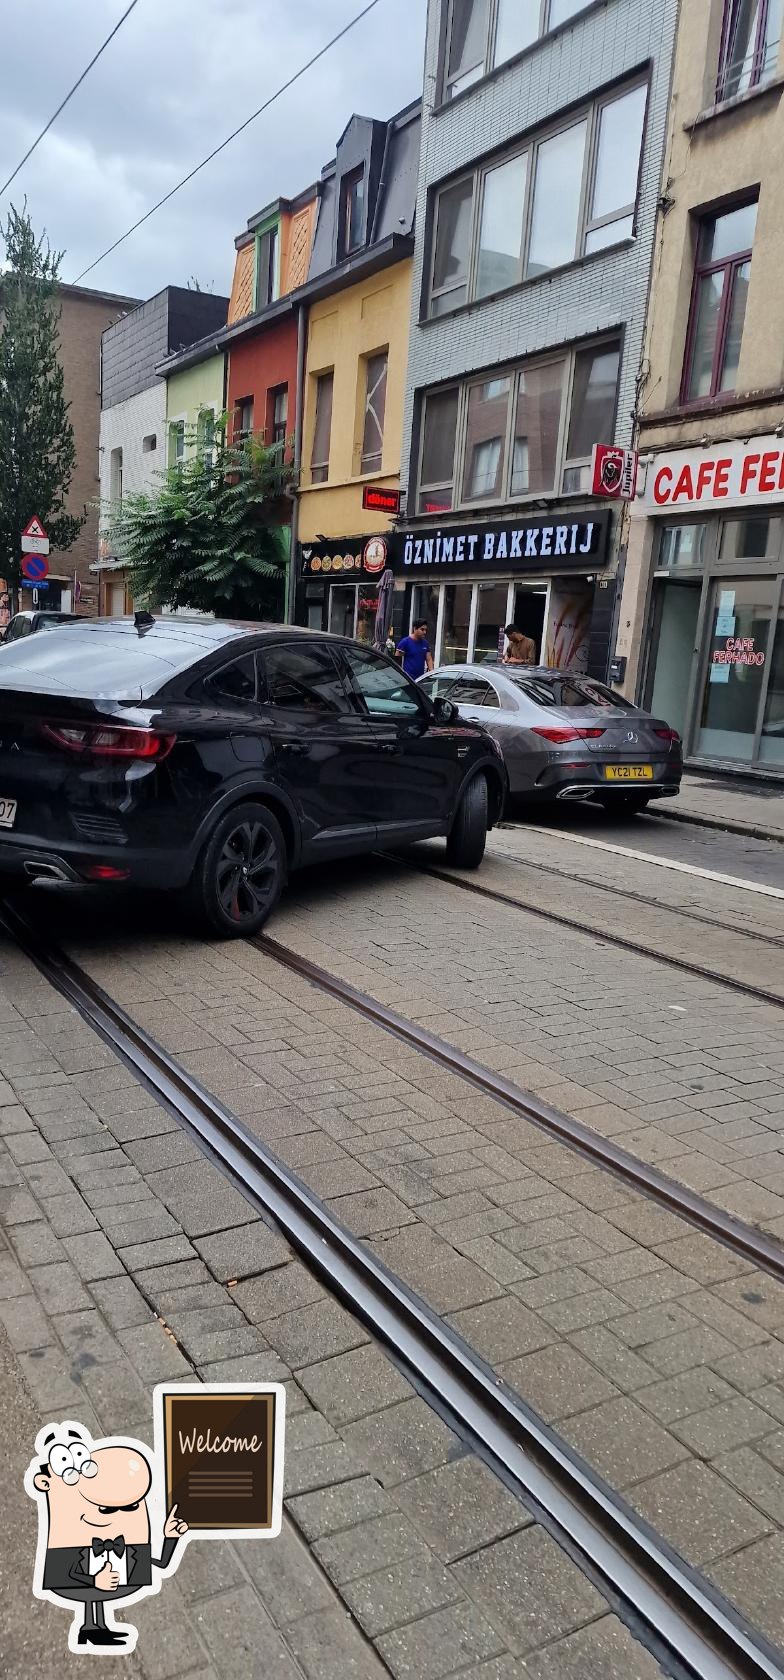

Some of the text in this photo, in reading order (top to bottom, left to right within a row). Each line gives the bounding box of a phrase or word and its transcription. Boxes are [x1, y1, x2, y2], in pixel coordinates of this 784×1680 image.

[622, 453, 633, 495] Jupiler
[653, 458, 733, 505] CAFE
[367, 493, 397, 507] döner
[404, 522, 594, 565] ÖZNİMET BAKKERIJ
[726, 637, 755, 651] CAFE
[712, 650, 765, 666] FERHADO
[611, 767, 648, 777] YC21 TZL
